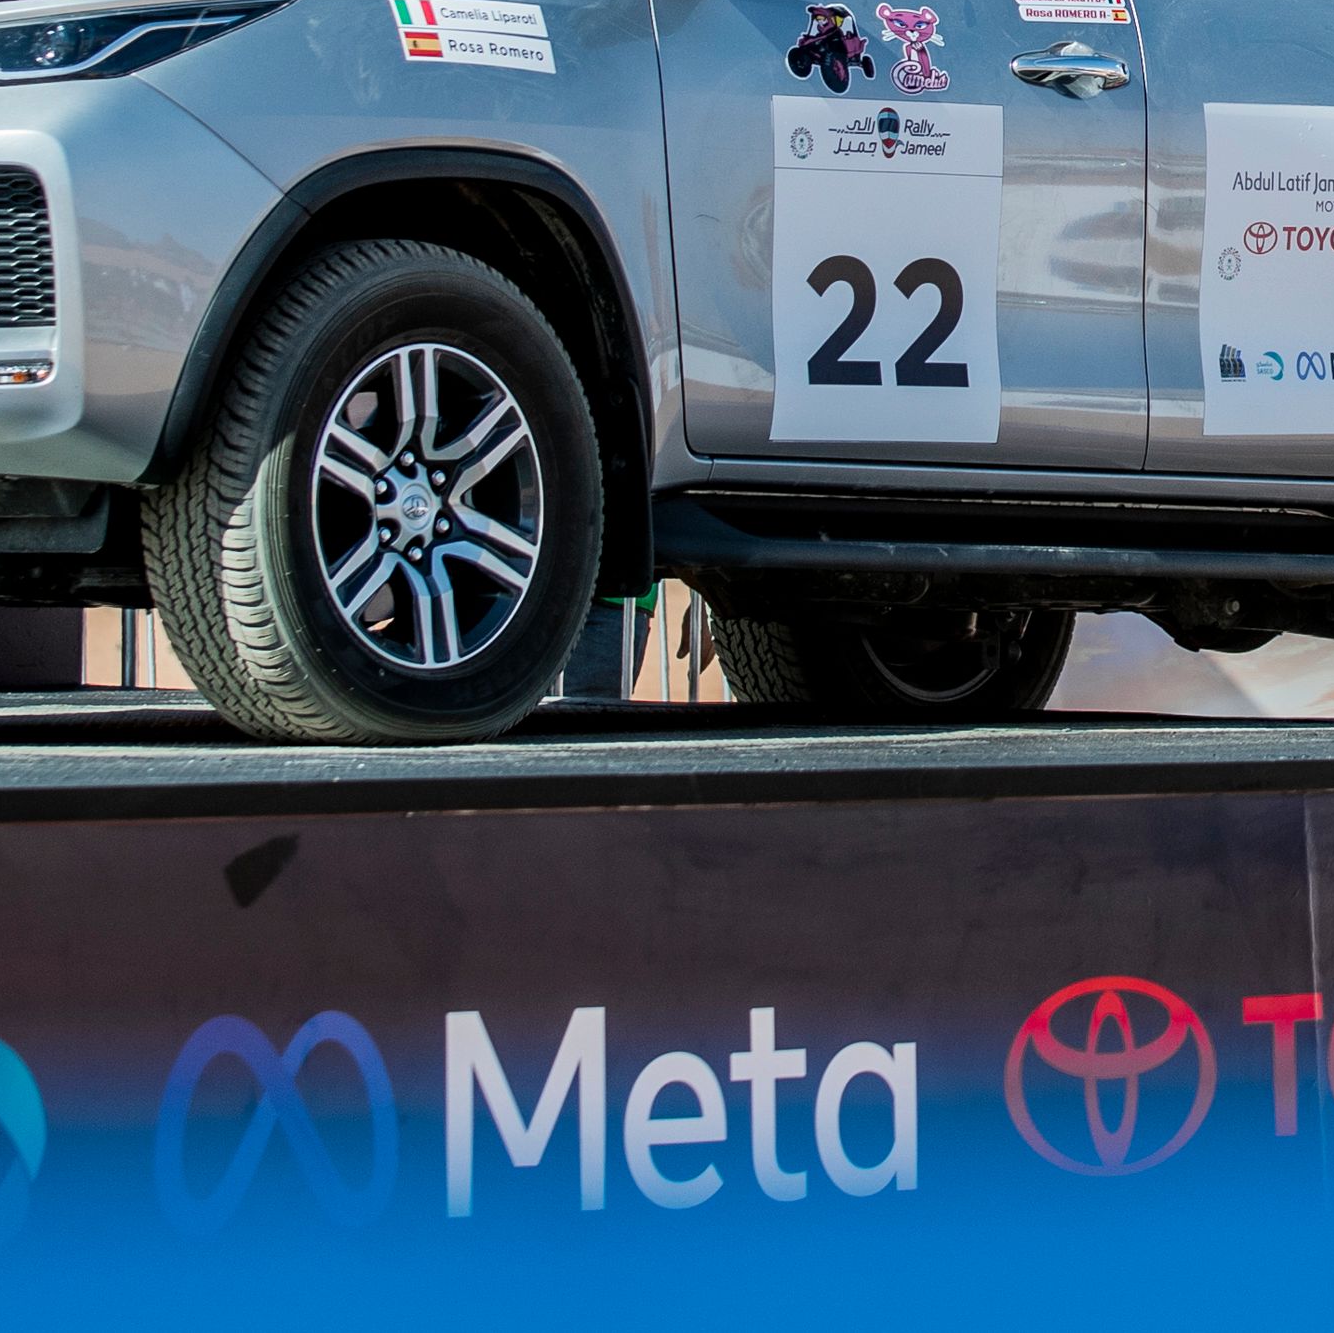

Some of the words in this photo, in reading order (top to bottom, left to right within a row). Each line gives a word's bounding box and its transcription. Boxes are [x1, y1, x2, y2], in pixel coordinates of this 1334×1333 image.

[439, 7, 490, 22] Camelia
[492, 10, 538, 26] Liparoti
[1025, 8, 1053, 18] Rosa
[1055, 9, 1097, 19] ROMERO
[448, 39, 485, 55] Rosa
[489, 42, 545, 62] Romero
[891, 59, 948, 95] Camelia
[903, 118, 935, 137] Rally
[833, 137, 878, 157] جميل
[900, 140, 947, 156] Jameel
[1232, 171, 1276, 193] Abdul
[1278, 171, 1312, 193] Latif
[805, 254, 970, 388] 22
[444, 1005, 918, 1219] Meta
